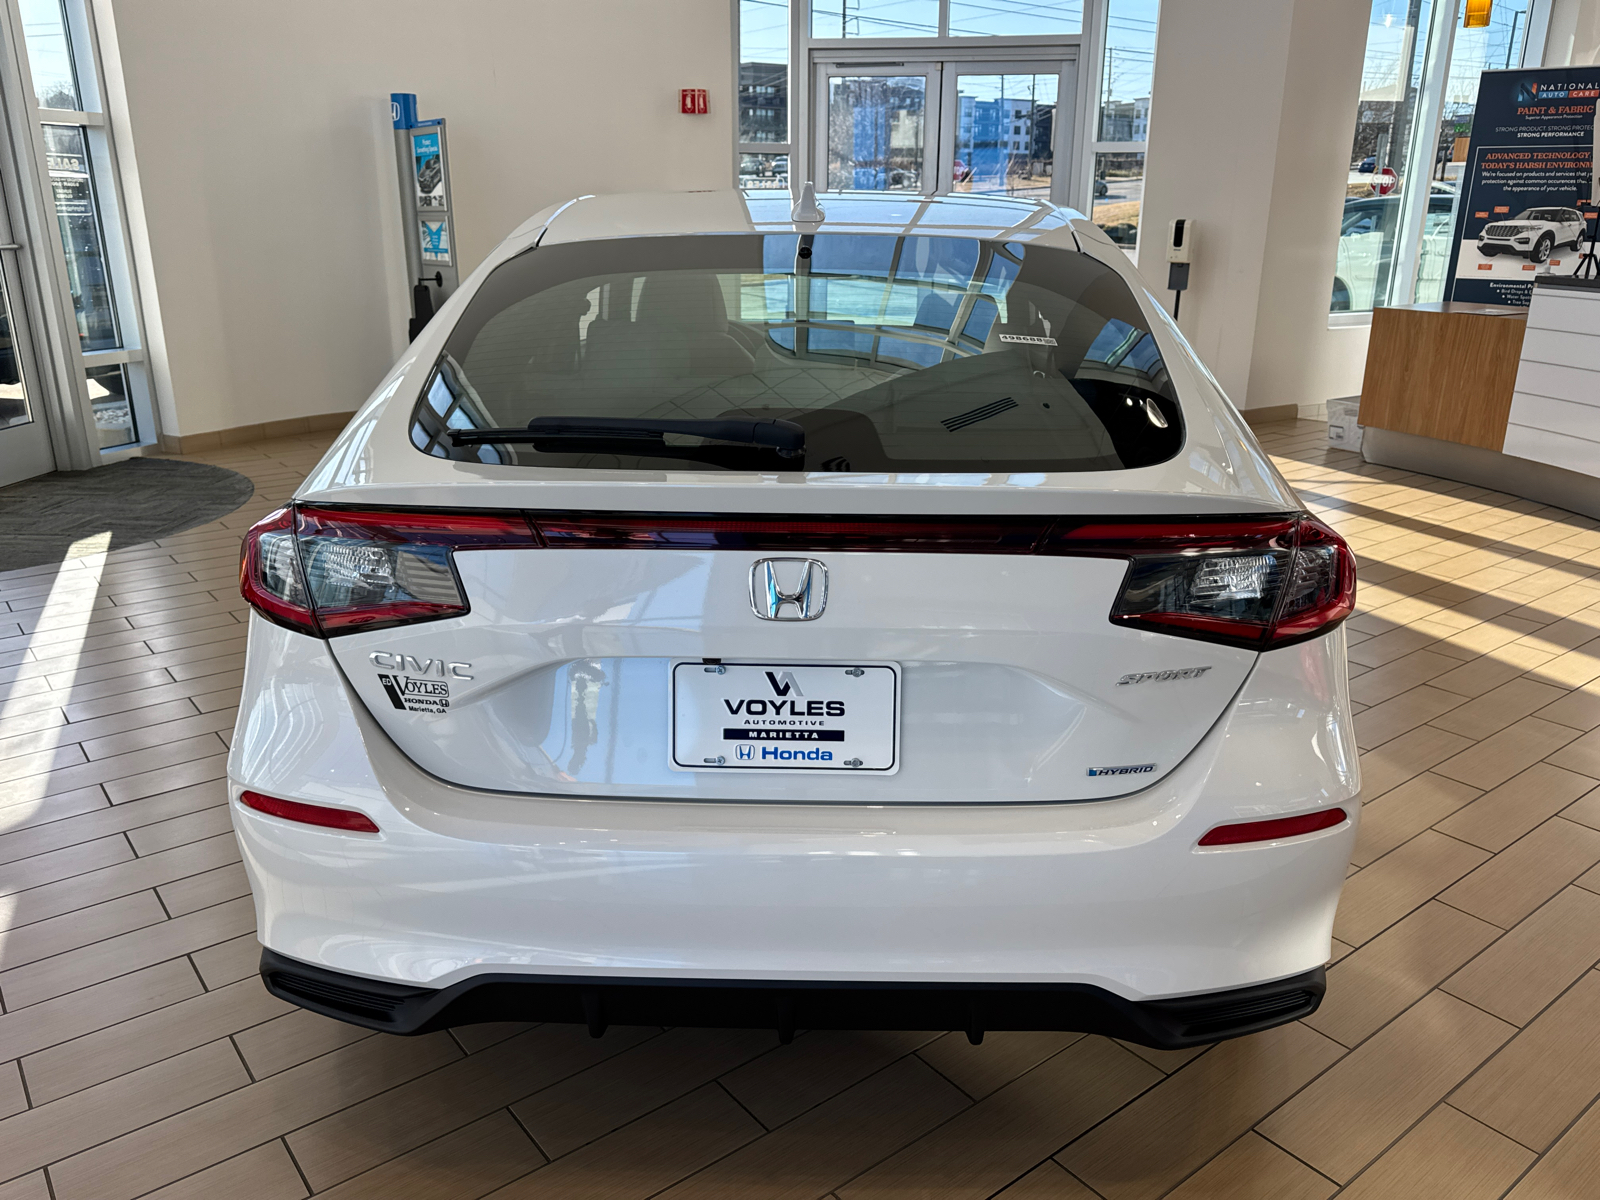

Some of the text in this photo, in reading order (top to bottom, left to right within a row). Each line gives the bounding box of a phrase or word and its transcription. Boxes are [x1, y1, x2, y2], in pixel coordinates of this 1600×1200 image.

[1540, 82, 1600, 91] NATIONAL
[1517, 105, 1594, 115] PAINT & FABRIC
[1486, 152, 1531, 160] ADVANCED
[1372, 174, 1396, 187] STOP
[369, 650, 474, 681] CIVIC
[1115, 665, 1213, 687] SPORT
[382, 674, 448, 697] ED VOYLES
[404, 697, 440, 706] HONDA
[408, 705, 447, 714] Marietta, GA
[723, 699, 845, 717] VOYLES
[748, 731, 819, 739] MARIETTA
[761, 746, 833, 761] Honda
[1098, 766, 1154, 776] HYBRID
